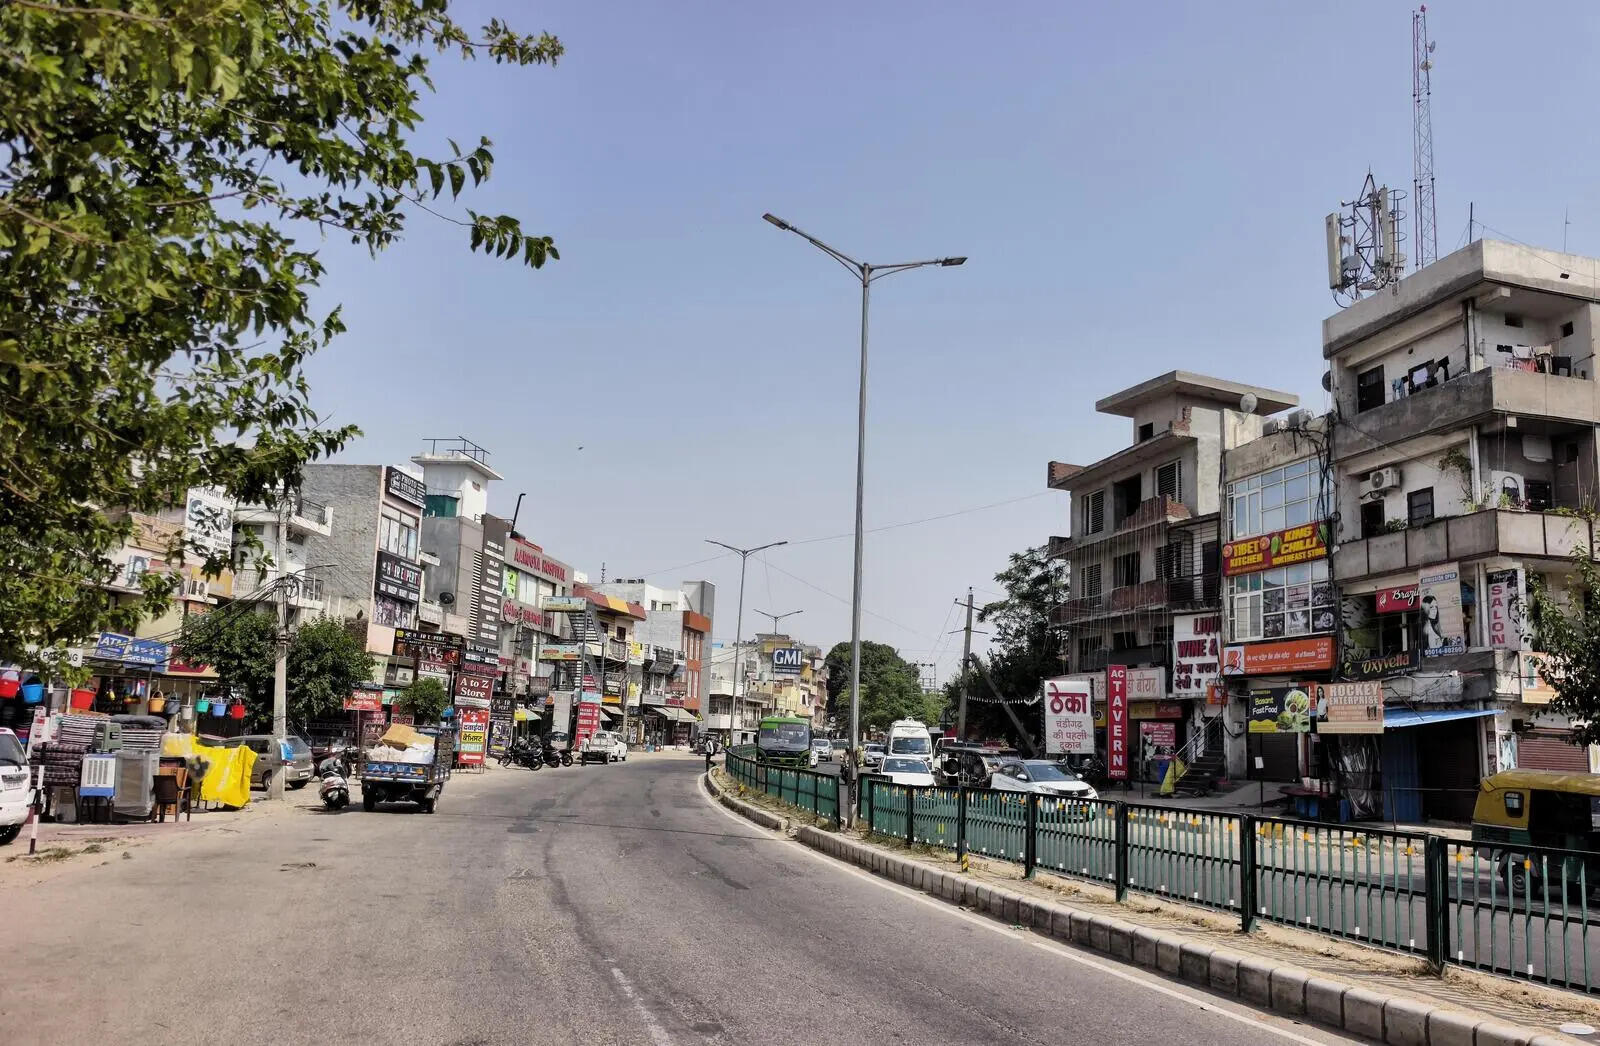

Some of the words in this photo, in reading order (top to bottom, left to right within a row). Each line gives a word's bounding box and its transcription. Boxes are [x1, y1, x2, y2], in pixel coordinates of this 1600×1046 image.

[1285, 526, 1313, 541] KING
[1233, 541, 1259, 557] TIBET
[1281, 537, 1317, 554] CHILLI
[1230, 553, 1263, 568] KITCHEN
[1272, 551, 1307, 565] NORTHEAST
[1307, 546, 1327, 558] STORE
[1491, 585, 1505, 644] SALON
[1177, 639, 1206, 657] WINE
[1111, 670, 1124, 678] AC
[460, 678, 467, 686] A
[470, 680, 479, 688] to
[481, 680, 490, 689] Z
[1329, 683, 1379, 697] ROCKEY
[460, 687, 486, 697] Store
[1047, 682, 1088, 714] ठेका
[1254, 697, 1274, 706] Basant
[1329, 696, 1378, 706] ENTERPRISE
[1112, 681, 1123, 766] TAVERN
[1053, 730, 1063, 740] की
[1065, 729, 1088, 741] पहली
[1060, 741, 1081, 753] दुकान
